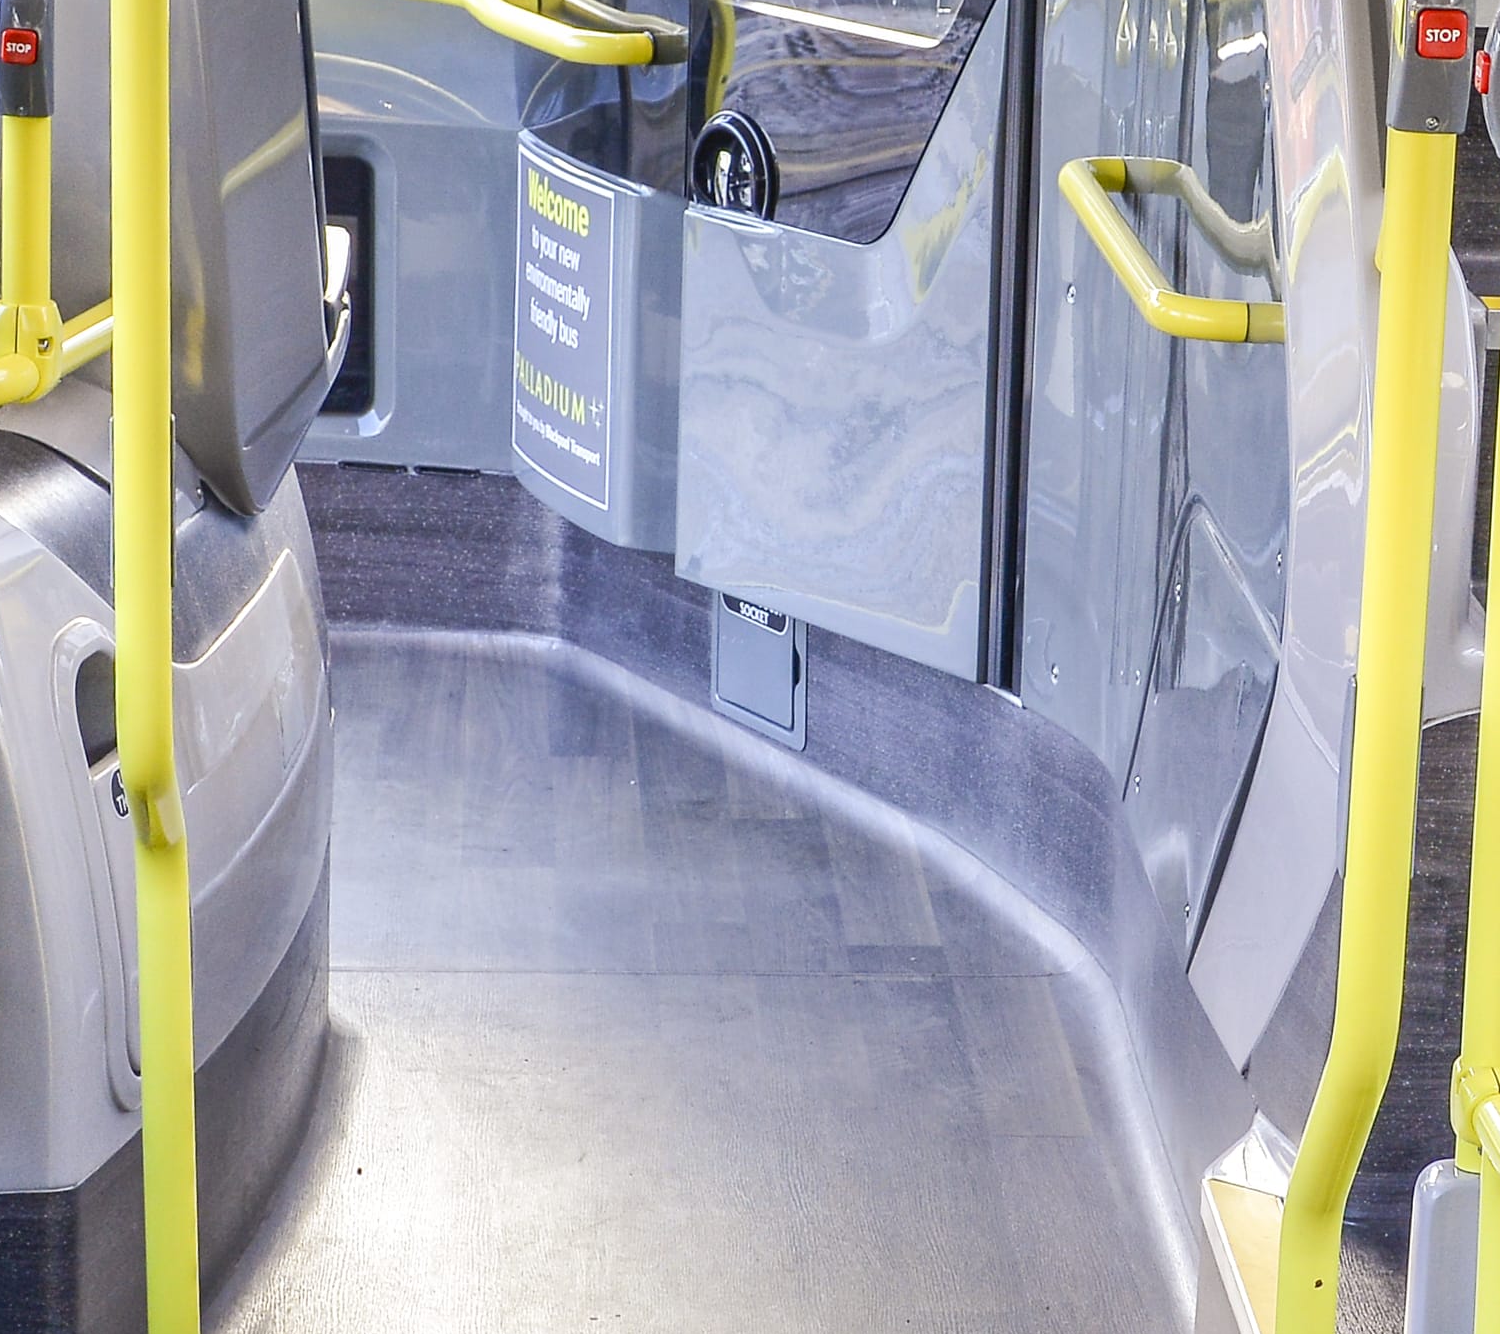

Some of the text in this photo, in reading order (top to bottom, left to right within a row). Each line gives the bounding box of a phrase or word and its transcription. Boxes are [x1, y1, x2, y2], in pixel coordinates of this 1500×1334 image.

[5, 42, 33, 55] STOP
[1425, 28, 1461, 42] STOP
[527, 167, 590, 238] Welcome
[531, 224, 581, 272] to your new
[529, 297, 580, 349] friendly bus
[516, 350, 587, 427] PALLADIUM
